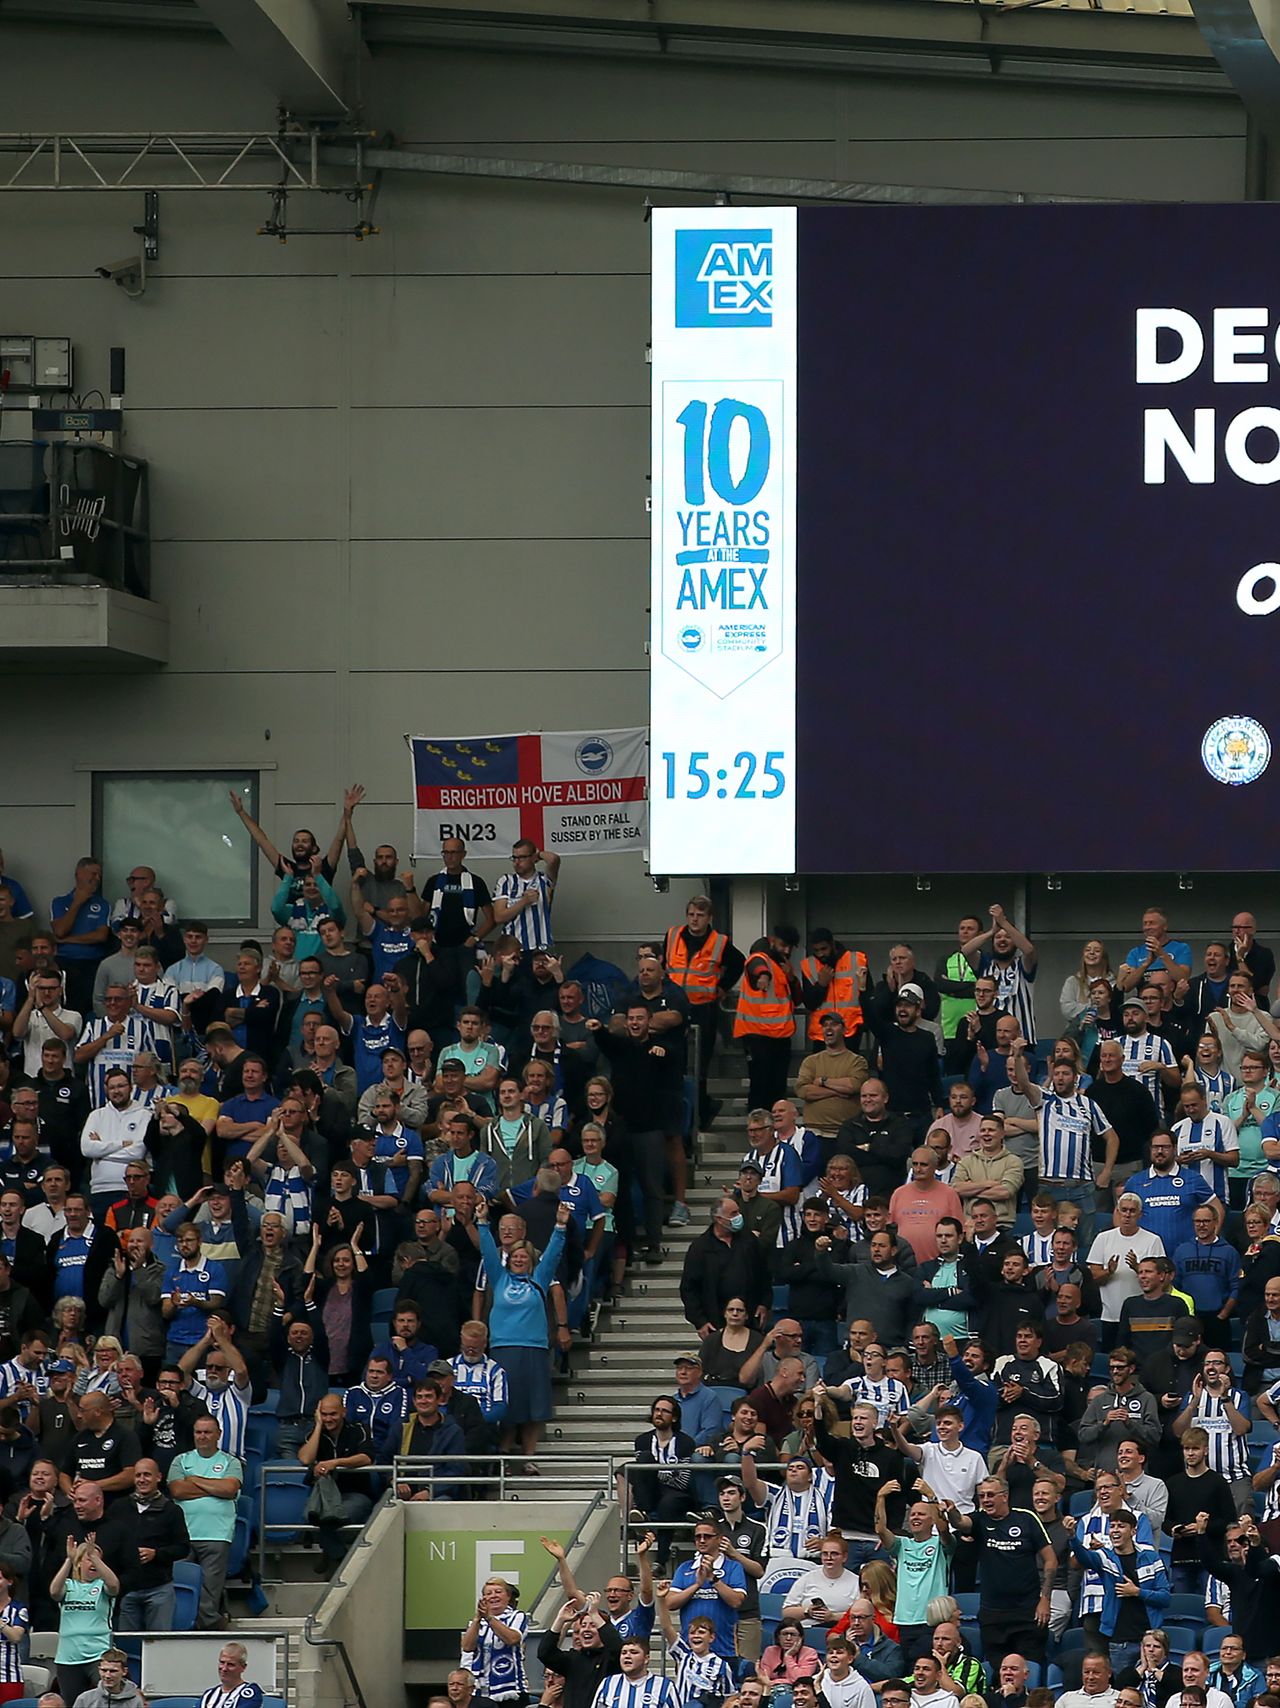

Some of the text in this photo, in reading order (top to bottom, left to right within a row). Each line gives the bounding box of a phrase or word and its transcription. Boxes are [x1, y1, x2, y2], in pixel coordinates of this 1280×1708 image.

[702, 247, 772, 277] AM
[712, 280, 772, 310] EX
[676, 397, 771, 506] 10
[676, 510, 770, 547] YEARS
[706, 548, 740, 562] AT THE
[675, 568, 769, 610] AMEX
[662, 751, 786, 800] 15:25
[440, 782, 622, 806] BRIGHTON HOVE ALBION
[561, 813, 630, 828] STAND OR FALL
[439, 823, 497, 842] BN23
[551, 827, 641, 843] SUSSEX BY THE SEA
[619, 1319, 627, 1331] T
[600, 1355, 608, 1367] S
[577, 1391, 585, 1402] R
[429, 1541, 457, 1561] N1
[476, 1540, 525, 1616] F
[767, 1569, 803, 1587] BRIGHTON
